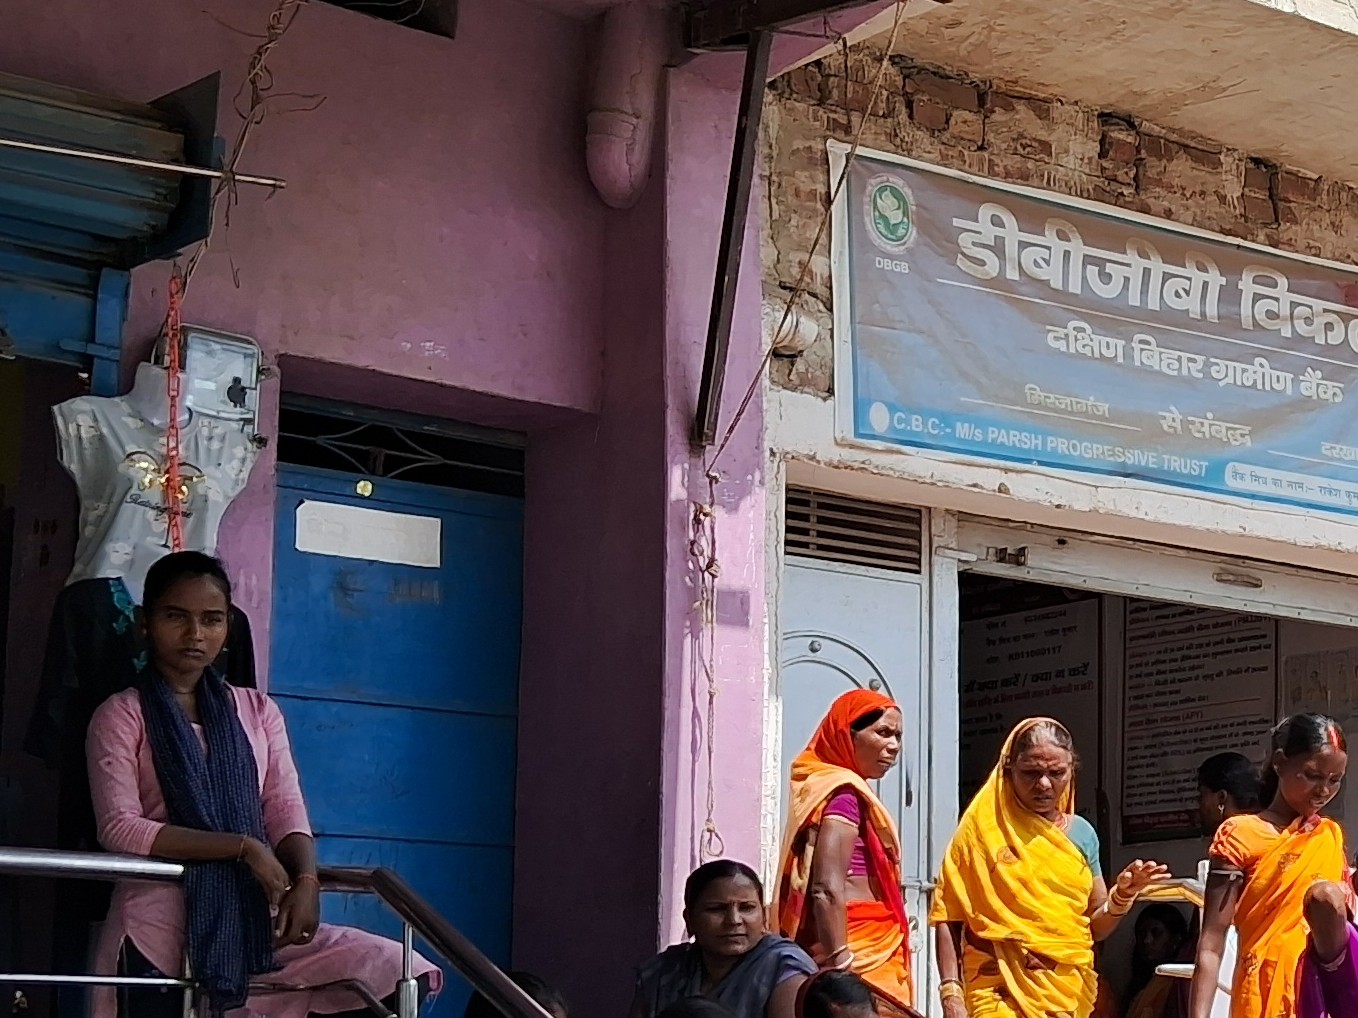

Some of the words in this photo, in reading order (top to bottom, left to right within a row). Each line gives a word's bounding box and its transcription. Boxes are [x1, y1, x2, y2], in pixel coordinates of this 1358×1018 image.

[875, 257, 910, 274] DBGB
[952, 202, 1226, 323] डीबीजीबी
[1046, 320, 1126, 363] दक्षिण
[1132, 333, 1206, 379] बिहार
[1210, 356, 1294, 396] ग्रामीण
[1299, 367, 1345, 404] बैंक
[1158, 404, 1183, 435] से
[955, 420, 984, 442] M/s
[987, 427, 1043, 451] PARSH
[1046, 437, 1158, 469] PROGRESSIVE
[1161, 454, 1210, 478] TRUST
[1270, 477, 1283, 489] का
